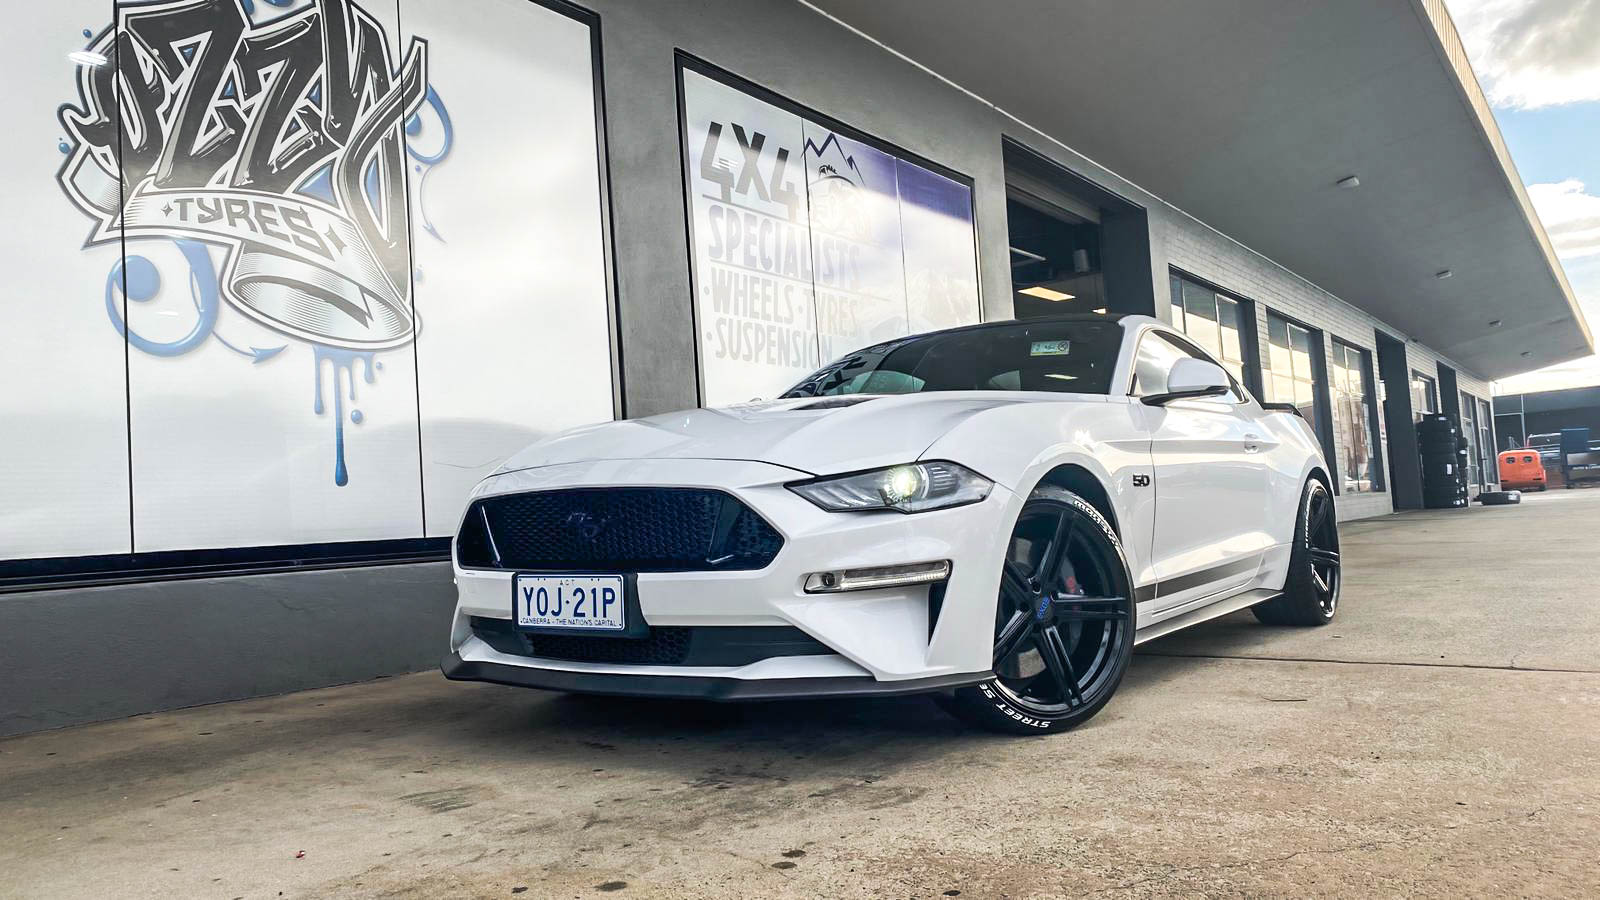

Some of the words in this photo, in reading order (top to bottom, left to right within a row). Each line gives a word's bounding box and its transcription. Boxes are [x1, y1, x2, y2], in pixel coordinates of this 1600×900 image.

[700, 121, 800, 223] 4X4
[173, 197, 336, 262] TYRES
[707, 204, 861, 288] SPECIALISTS
[711, 266, 794, 325] WHEELS
[802, 287, 859, 336] TYRES
[714, 317, 833, 369] SUSPENSION
[556, 618, 567, 626] THE
[995, 703, 1051, 728] STREET
